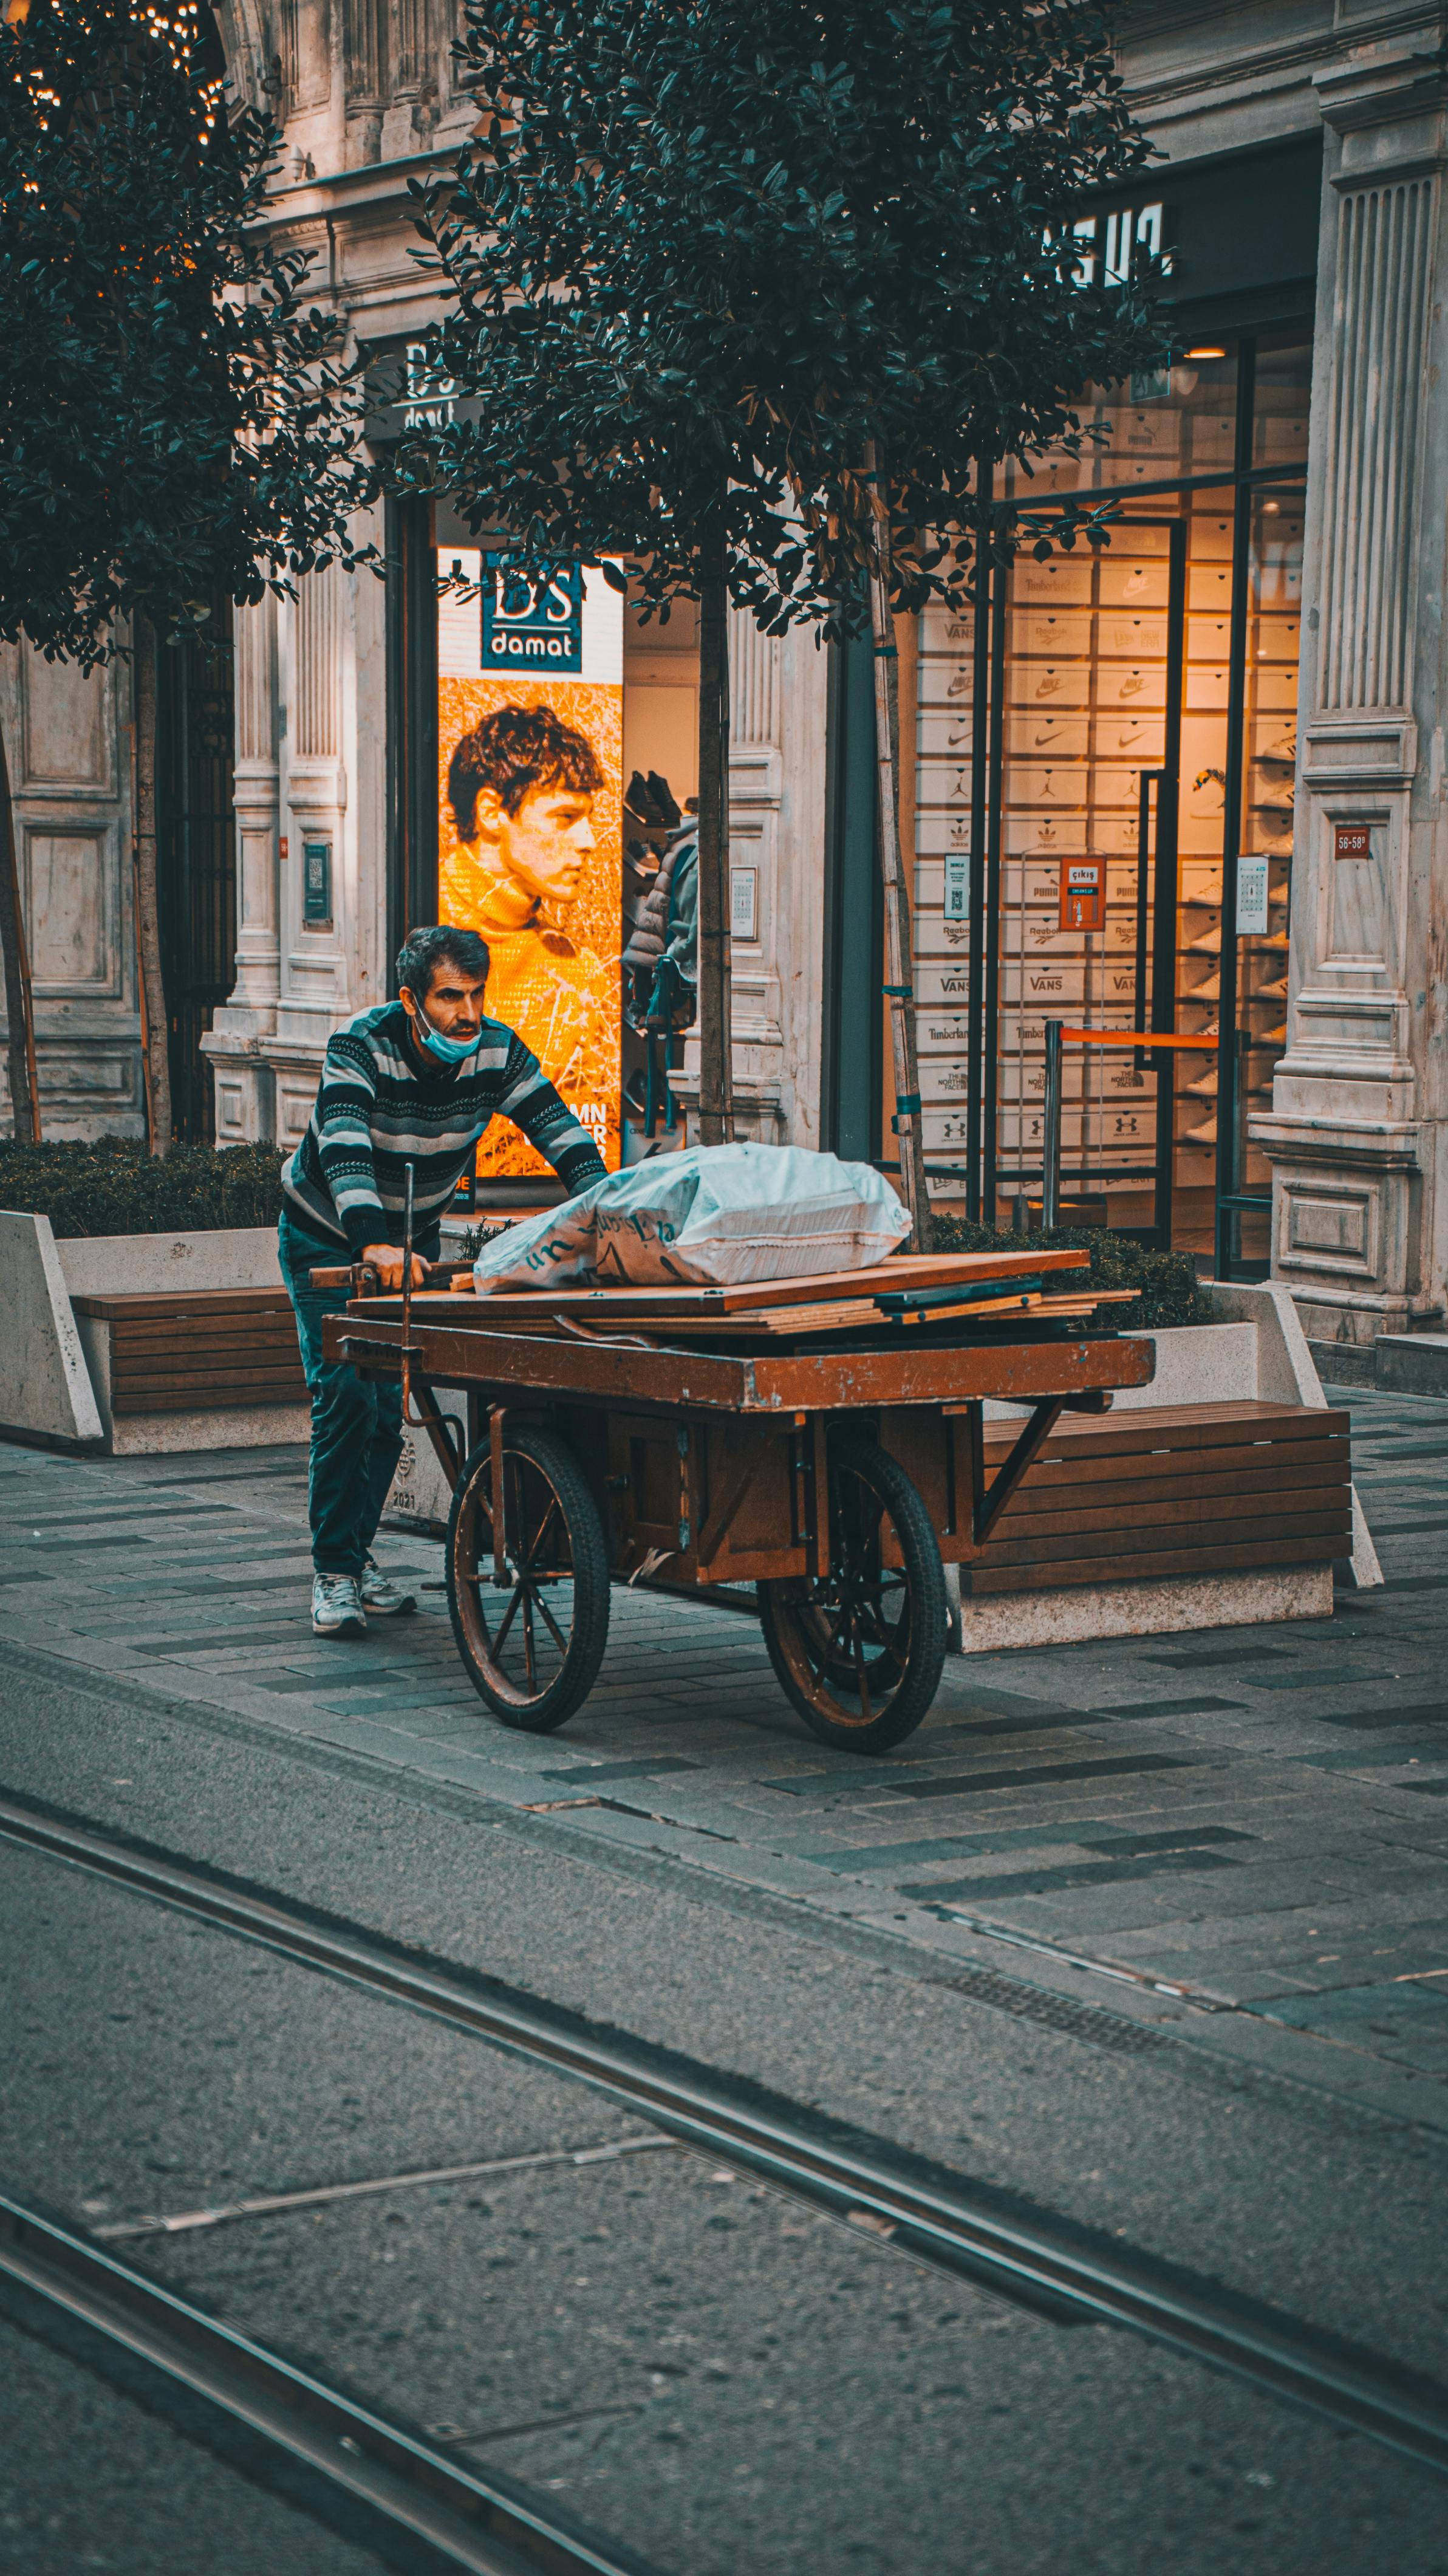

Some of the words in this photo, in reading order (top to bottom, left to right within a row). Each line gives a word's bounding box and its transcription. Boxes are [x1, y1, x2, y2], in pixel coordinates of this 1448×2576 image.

[491, 631, 572, 657] damat
[1040, 679, 1061, 689] NIKE
[1124, 679, 1145, 690] NIKE
[943, 927, 970, 936] Reebo
[1030, 976, 1063, 991] VANS
[1113, 976, 1136, 990] VAN
[929, 1027, 969, 1041] Timberlan
[393, 1491, 415, 1510] 2021
